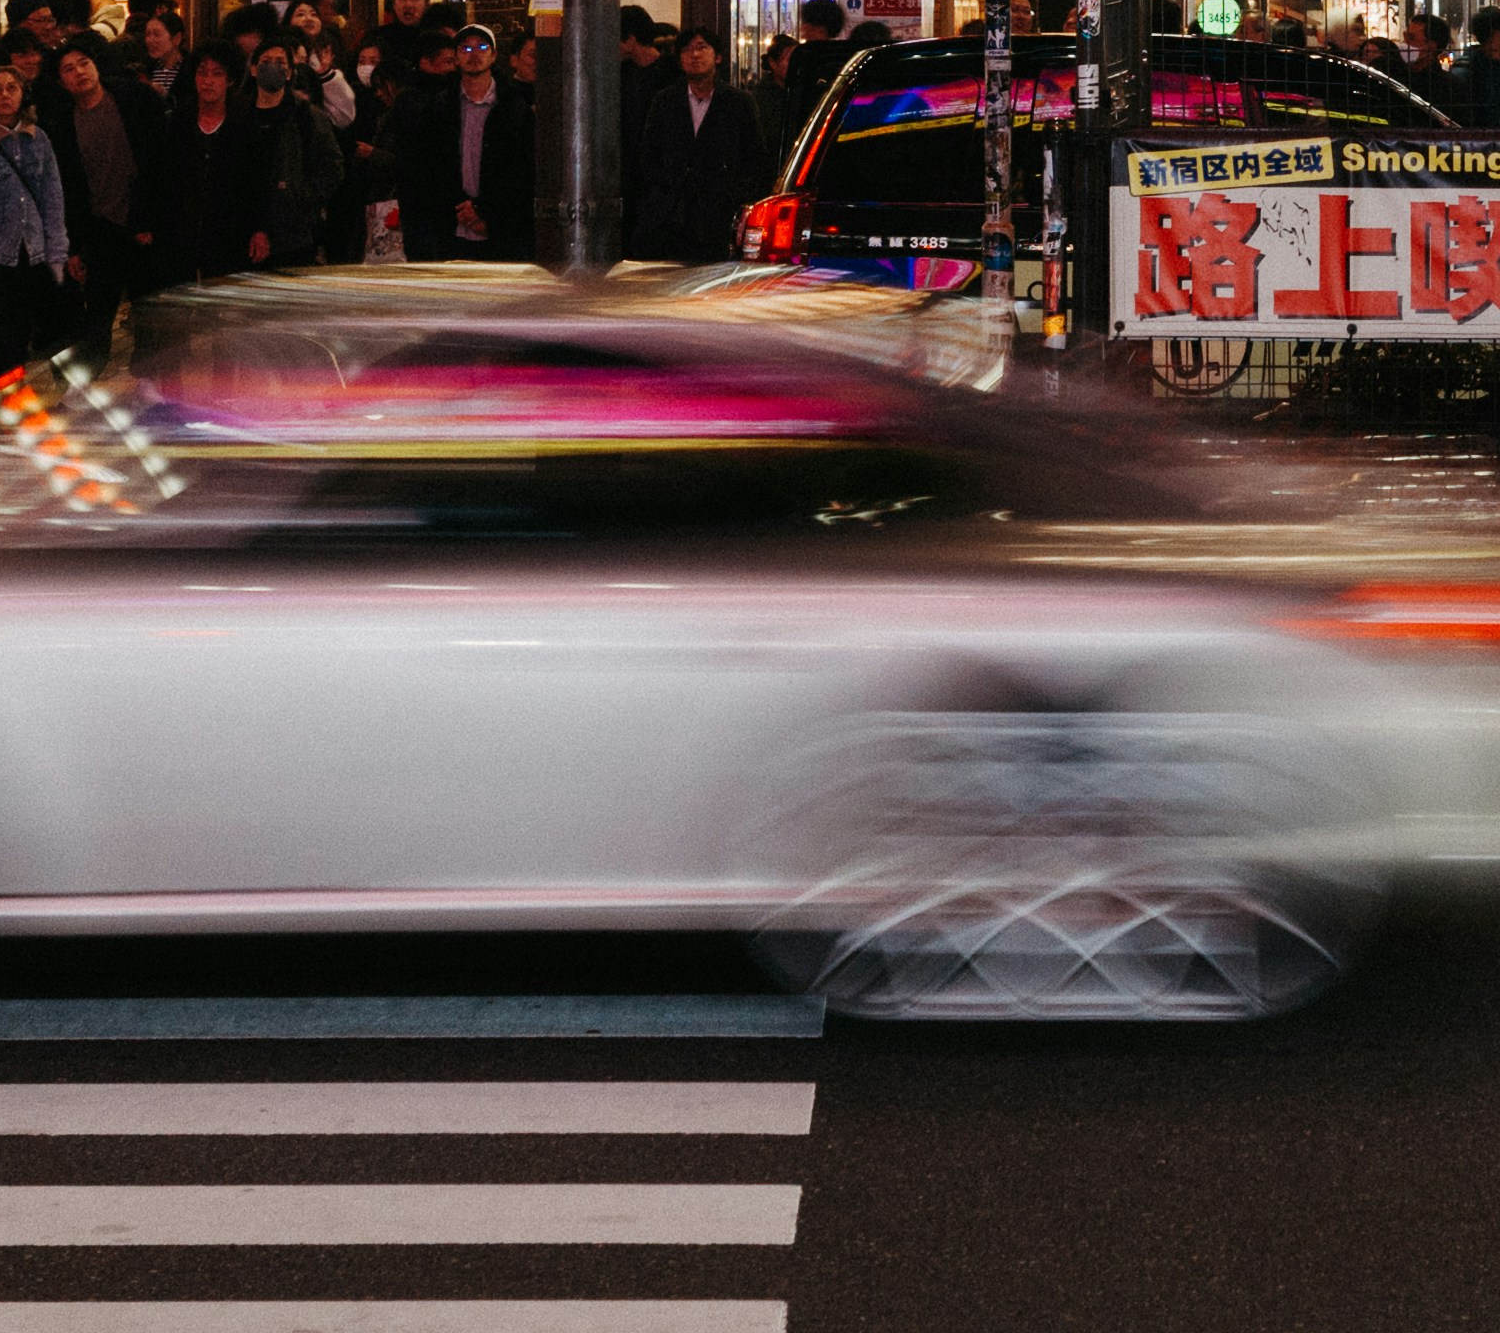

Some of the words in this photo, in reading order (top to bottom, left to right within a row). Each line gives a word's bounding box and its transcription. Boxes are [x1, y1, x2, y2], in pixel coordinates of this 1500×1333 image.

[1208, 12, 1231, 24] 3485
[1137, 145, 1327, 190] 新宿区内全域
[908, 235, 948, 250] 3485
